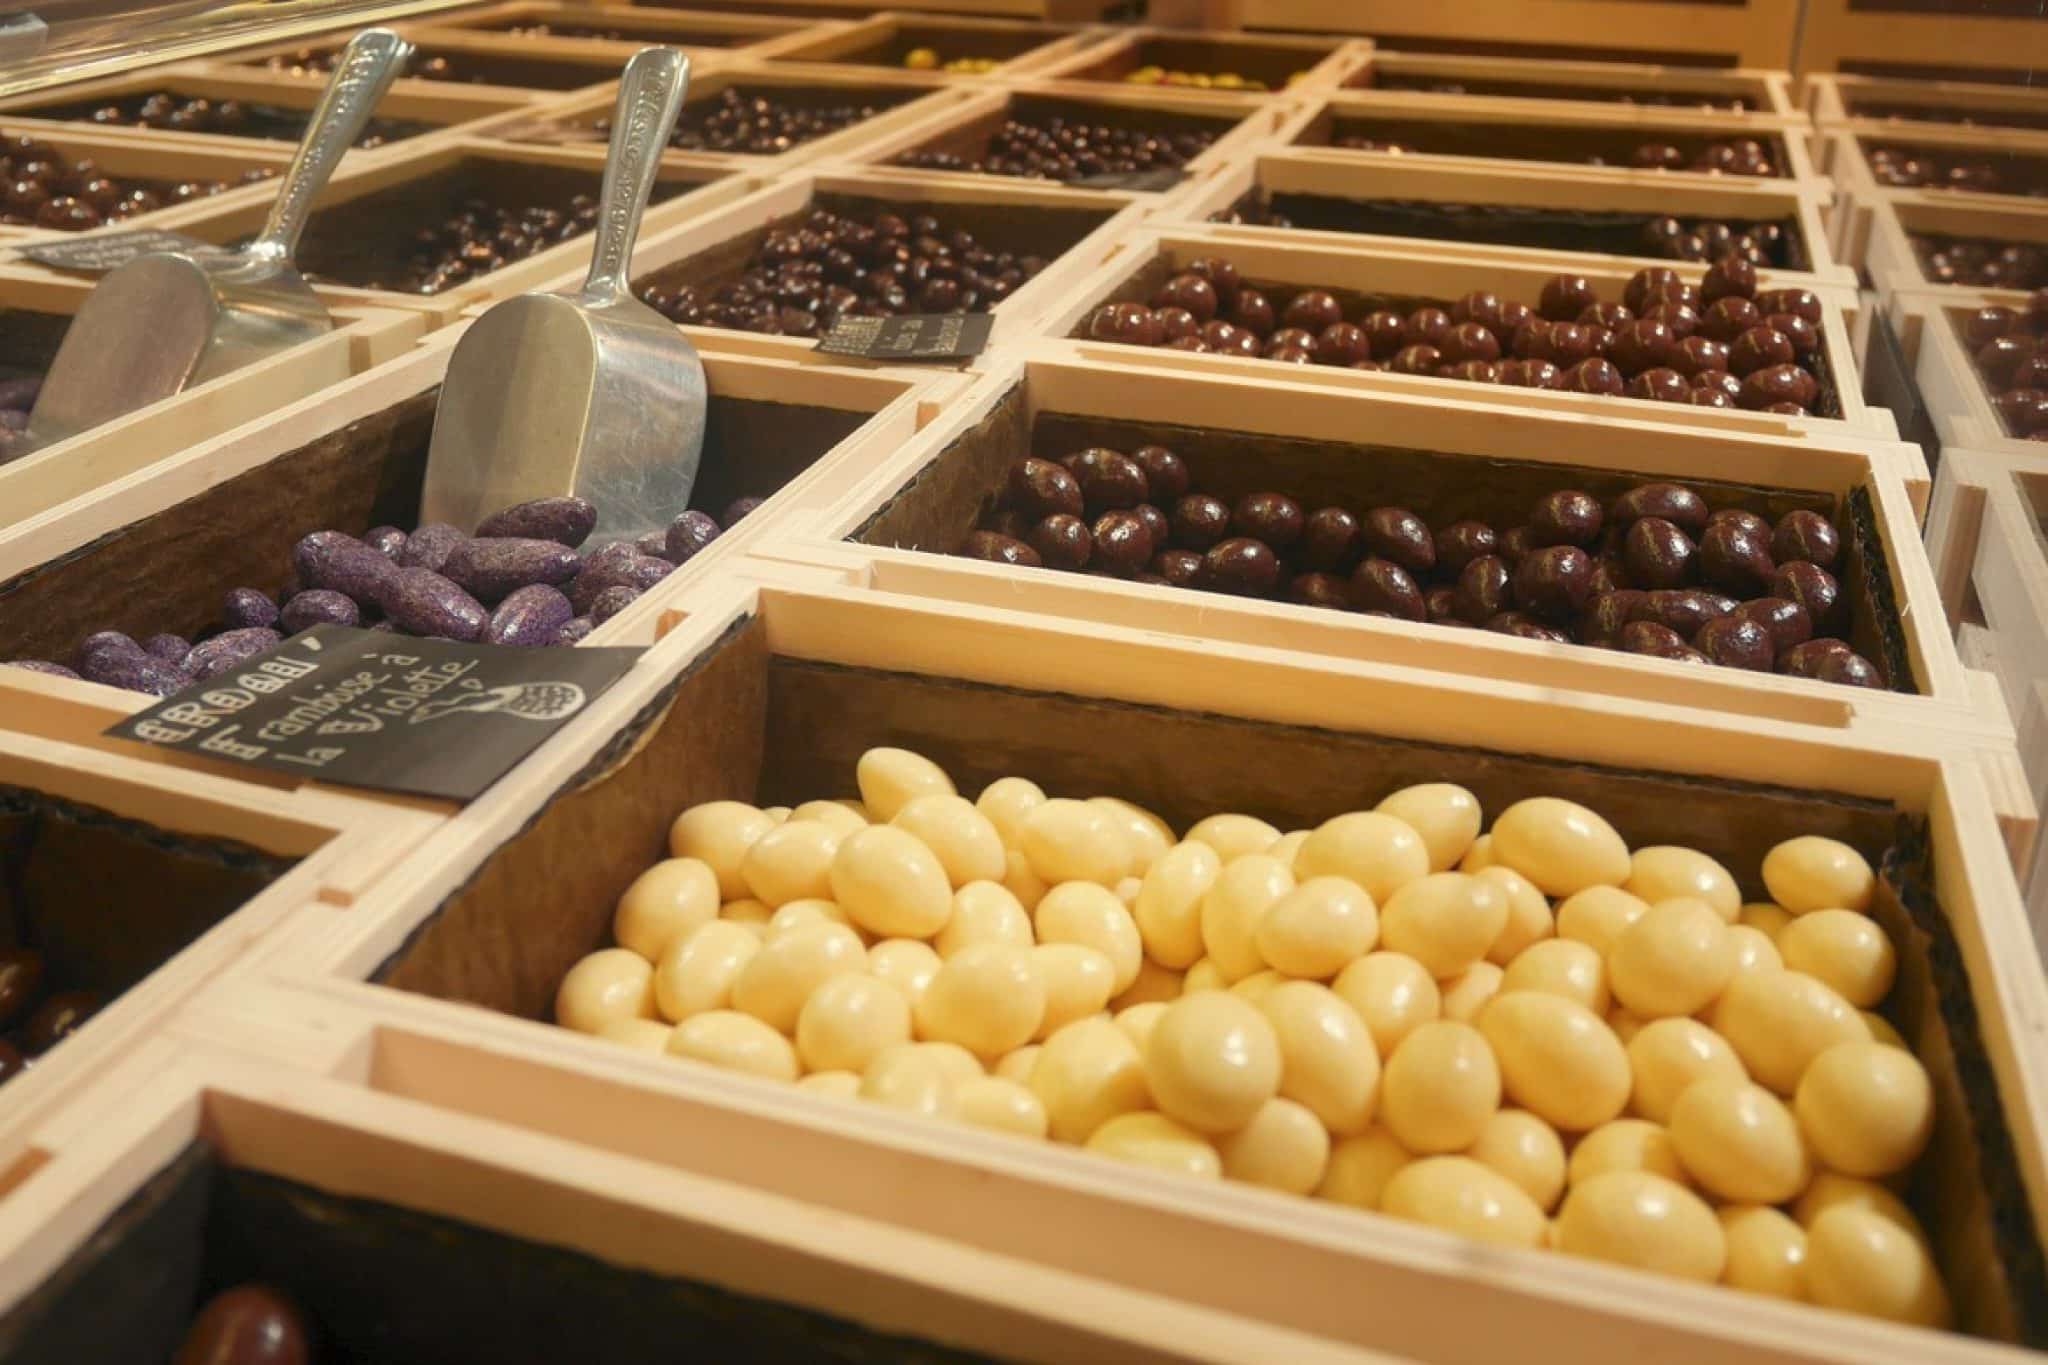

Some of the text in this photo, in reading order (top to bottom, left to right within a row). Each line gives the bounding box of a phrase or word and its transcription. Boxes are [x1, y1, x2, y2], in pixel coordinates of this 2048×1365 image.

[198, 671, 392, 760] Framboise
[274, 659, 479, 767] la Violette
